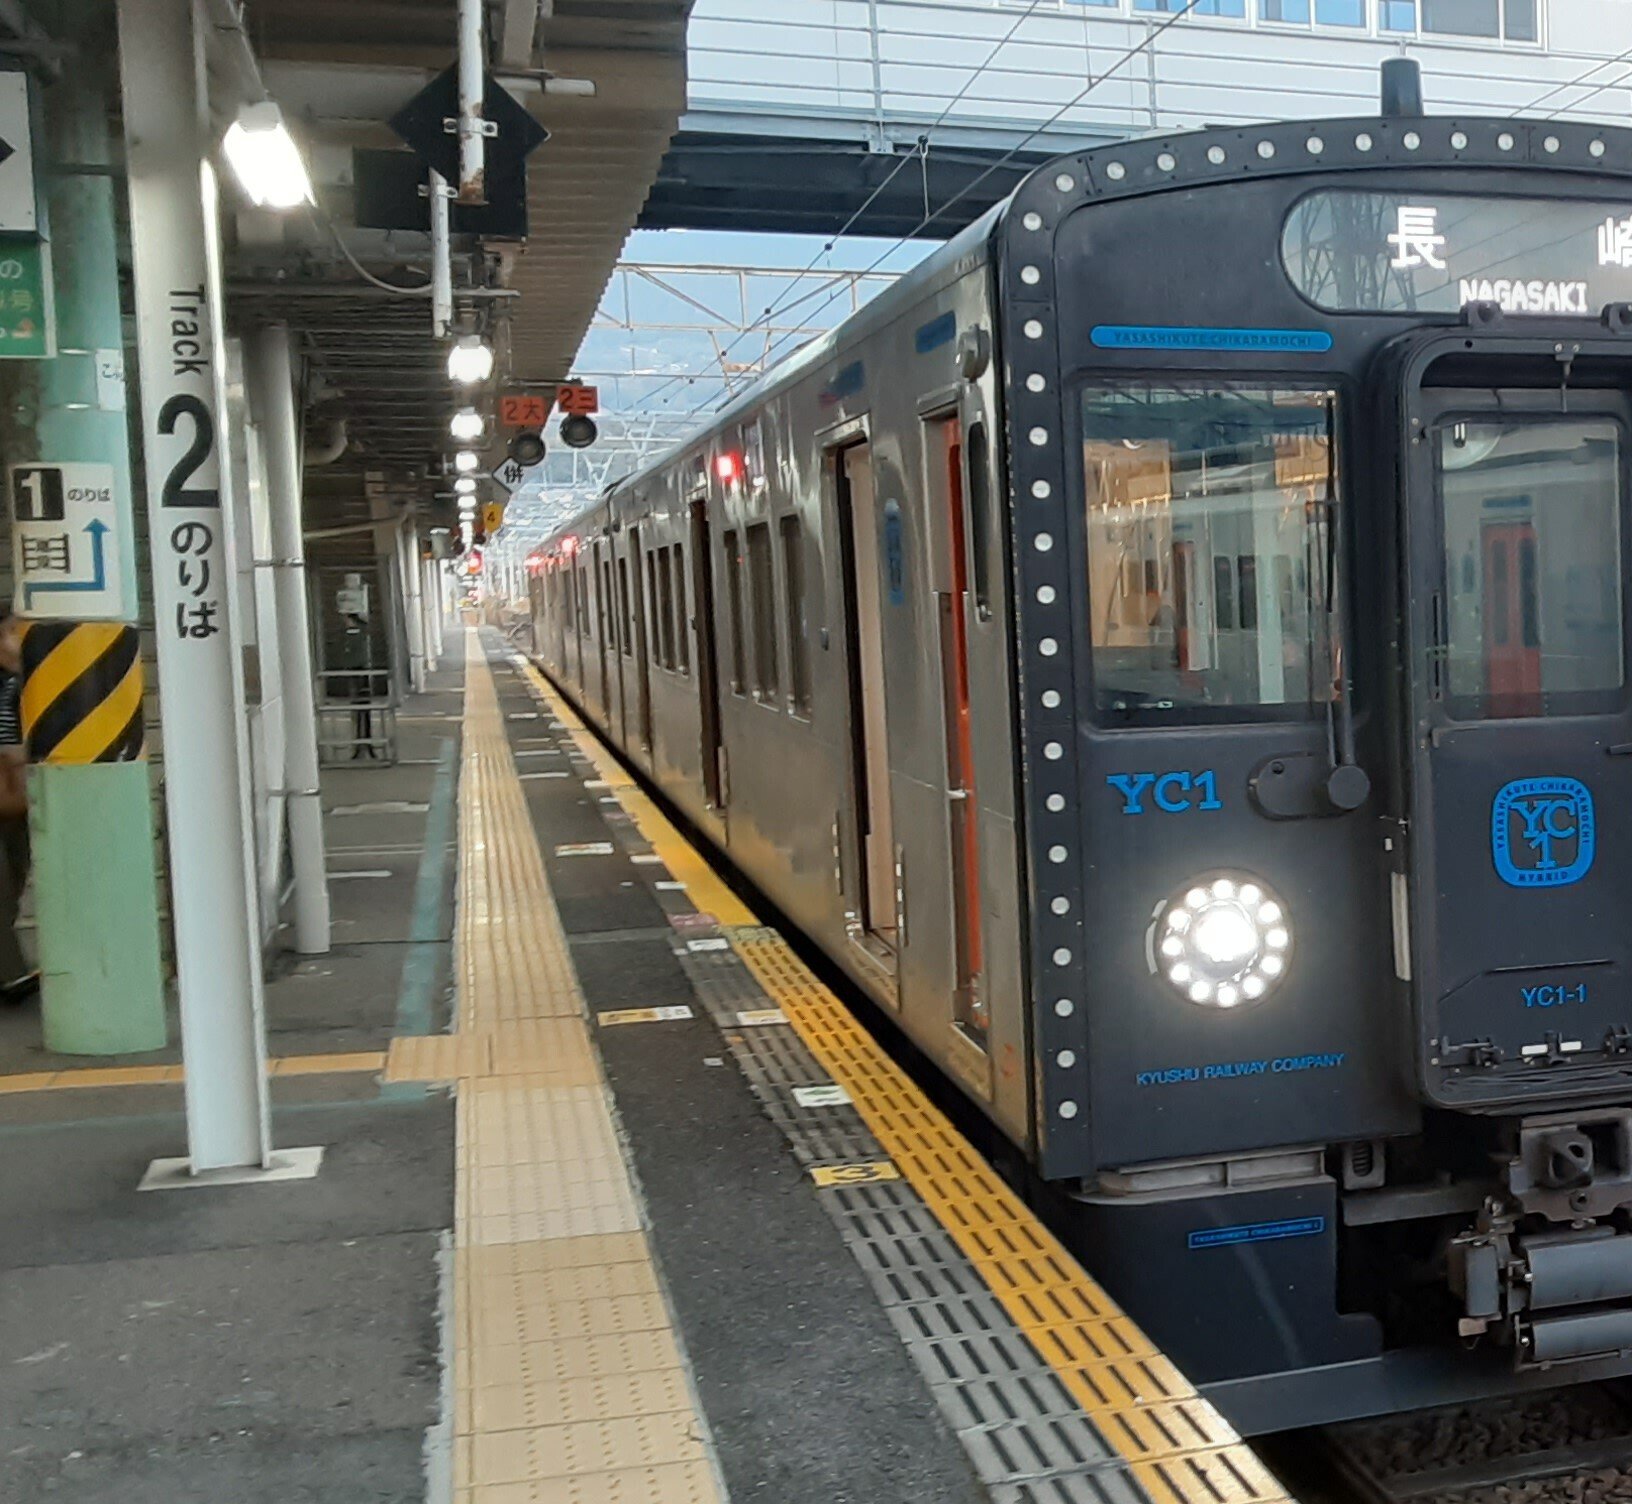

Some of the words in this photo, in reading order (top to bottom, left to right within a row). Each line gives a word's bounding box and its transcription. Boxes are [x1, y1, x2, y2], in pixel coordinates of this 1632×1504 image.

[1459, 279, 1588, 313] NAGASAKI
[168, 283, 209, 376] Track
[157, 394, 221, 508] 2
[21, 471, 44, 518] 1
[170, 521, 220, 640] のりば
[1106, 770, 1223, 814] YC1
[1508, 799, 1577, 839] YC
[1529, 831, 1557, 868] 1
[1518, 871, 1569, 882] HYBRID
[1520, 983, 1587, 1008] YC1-1
[1136, 1067, 1199, 1086] KYUSHU
[1203, 1060, 1267, 1079] RAILWAY
[1271, 1053, 1345, 1073] COMPANY
